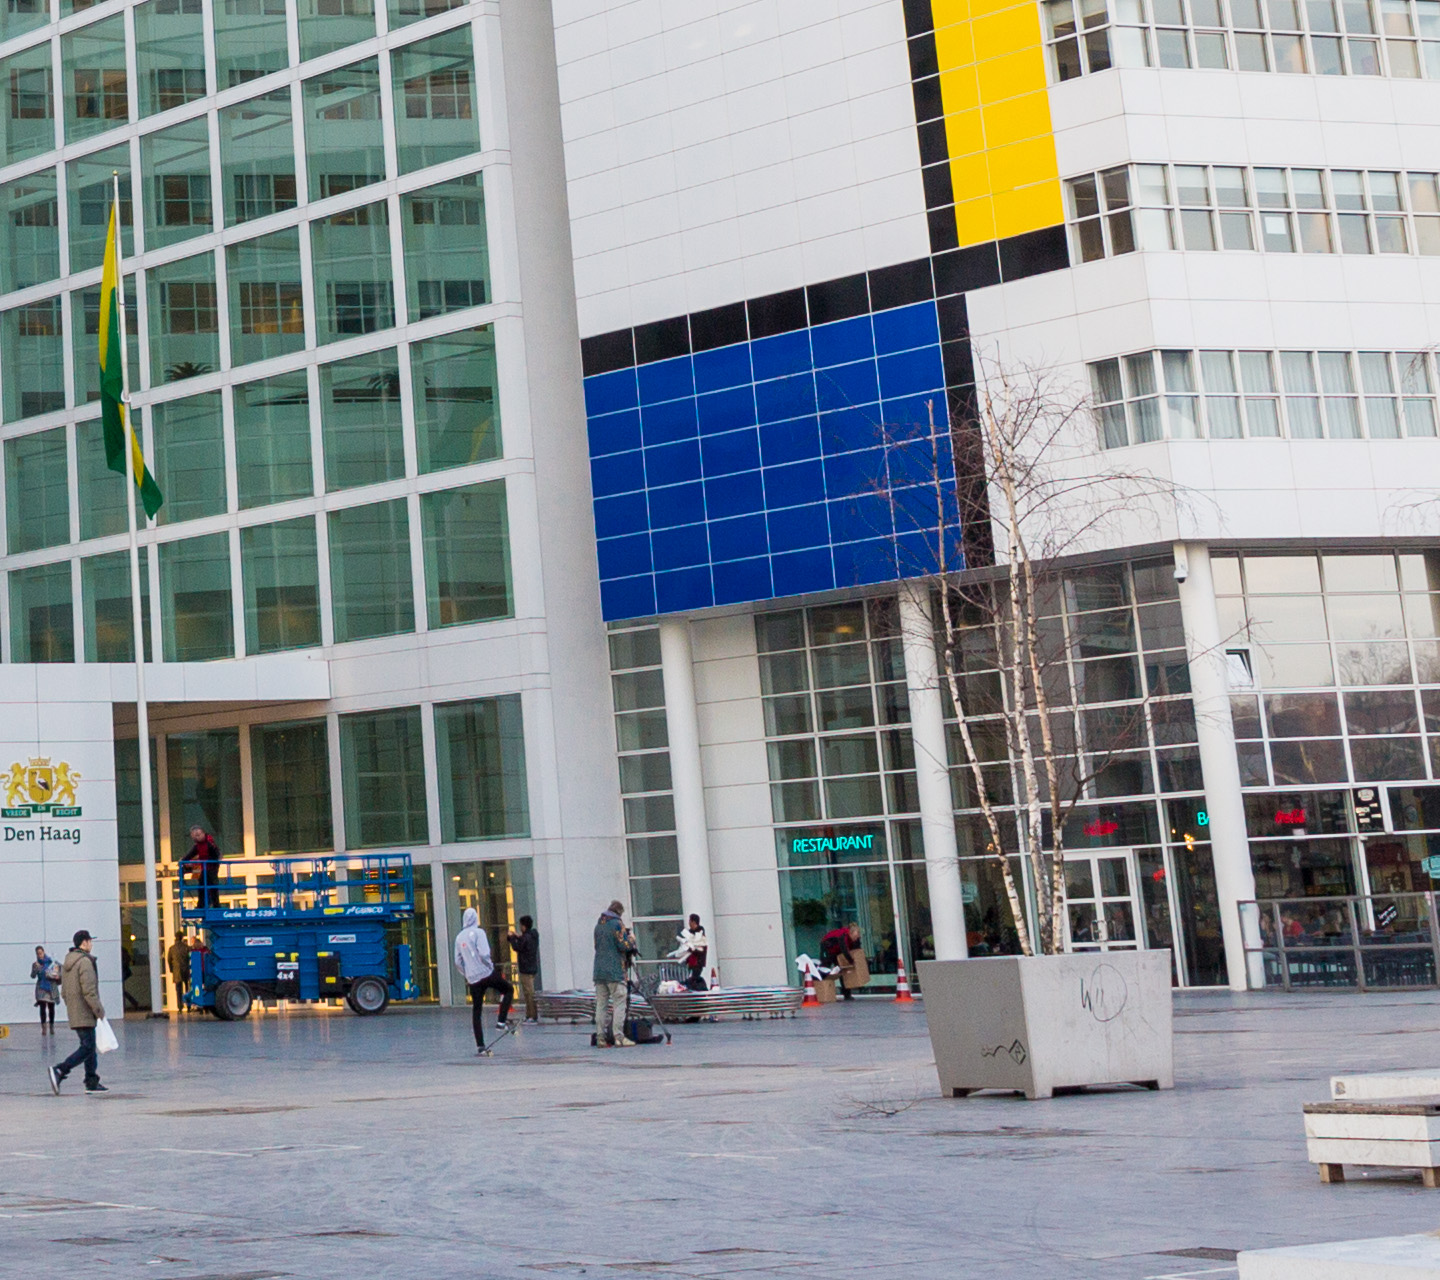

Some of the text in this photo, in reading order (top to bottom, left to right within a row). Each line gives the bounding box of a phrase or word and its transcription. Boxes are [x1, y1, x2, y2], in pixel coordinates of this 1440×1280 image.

[5, 809, 28, 817] VREDE
[4, 826, 81, 845] Den Haag
[793, 834, 874, 853] RESTAURANT
[277, 971, 294, 980] 4x4
